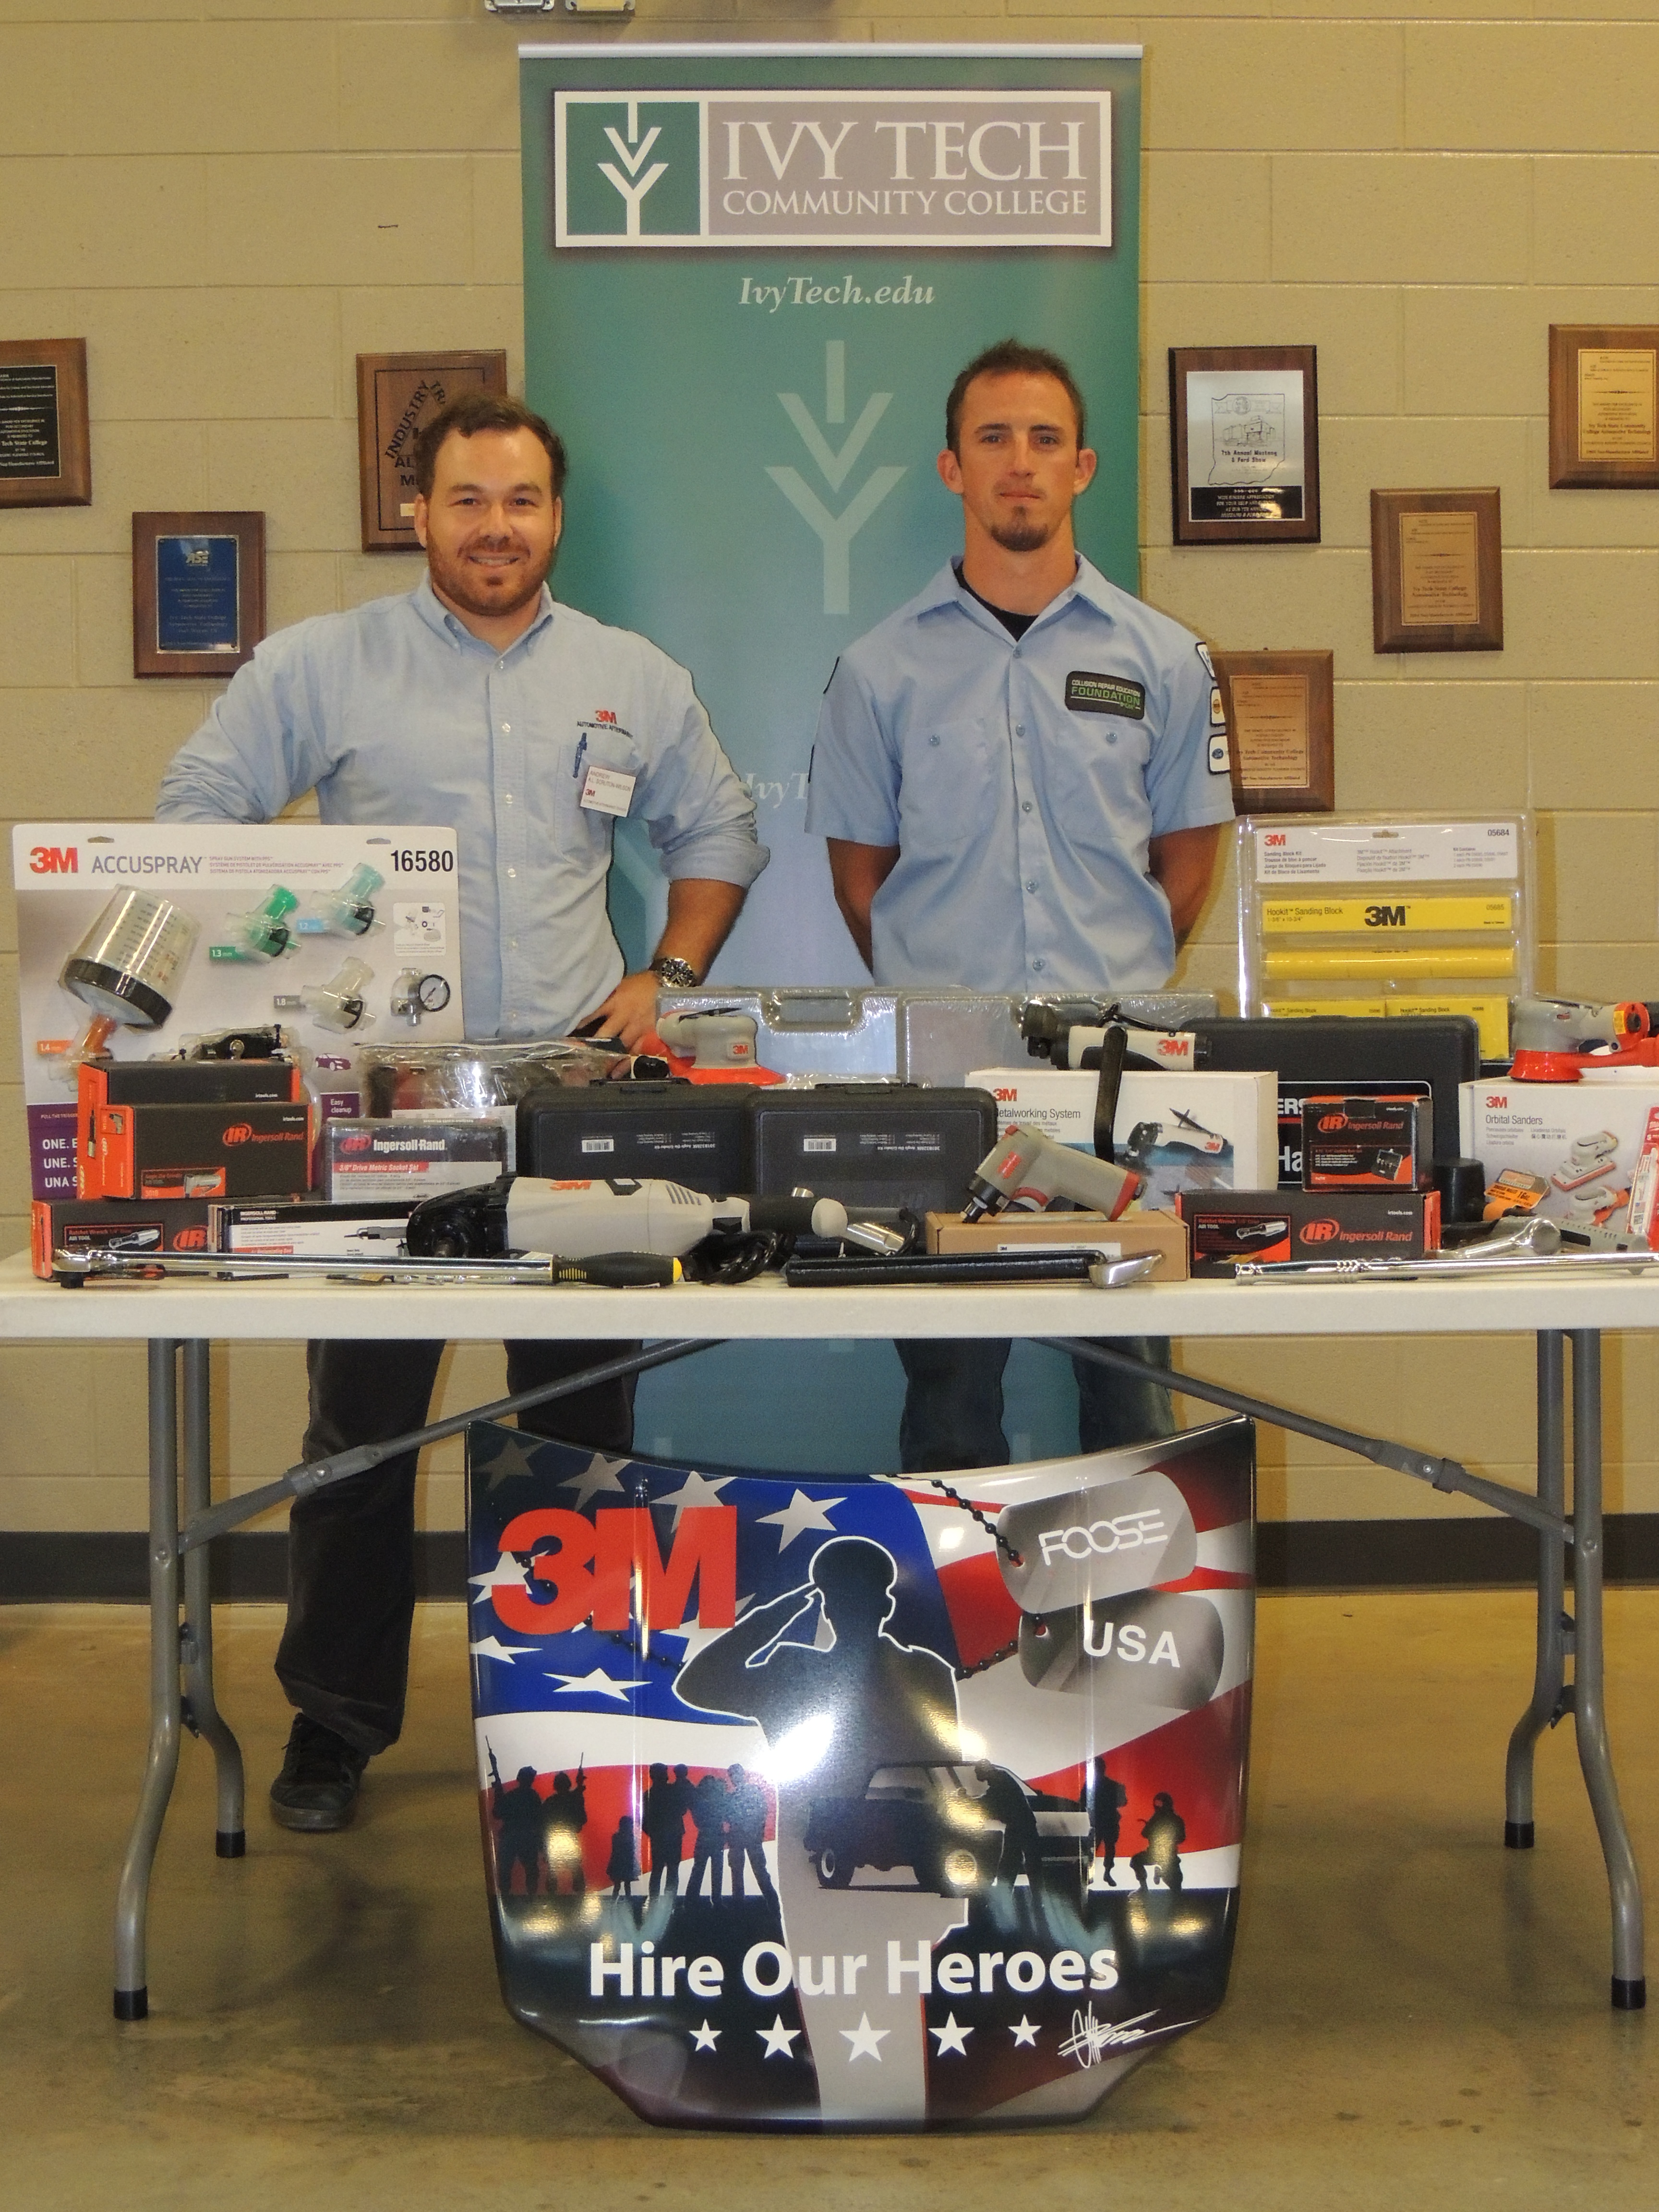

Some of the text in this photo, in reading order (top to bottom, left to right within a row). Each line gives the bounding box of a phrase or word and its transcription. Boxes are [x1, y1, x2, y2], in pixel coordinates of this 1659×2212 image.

[722, 120, 1087, 181] IVY TECH
[722, 190, 1087, 215] COMMUNITY COLLEGE
[738, 276, 935, 313] IvyTech.edu
[385, 380, 430, 459] INDUSTRY
[1071, 679, 1097, 688] COLLISION
[1116, 685, 1140, 697] EDUCATION
[1071, 686, 1140, 706] FOUNDATION
[595, 709, 617, 724] 3M
[585, 788, 595, 797] 3M
[1264, 834, 1286, 846] 3M
[29, 847, 78, 874] 3M
[390, 850, 454, 872] 16580
[1295, 907, 1322, 916] Sanding
[733, 1044, 748, 1054] 3M
[1157, 1039, 1189, 1056] 3M
[993, 1088, 1017, 1102] 3M
[1486, 1096, 1507, 1108] 3M
[331, 1106, 352, 1114] cleanup
[997, 1108, 1081, 1120] etalworking System
[1347, 1121, 1382, 1131] Ingersoll
[1486, 1115, 1543, 1126] Orbital Sanders
[42, 1138, 70, 1149] ONE.
[252, 1132, 304, 1144] Ingersoll Rand
[1204, 1142, 1221, 1151] 3M
[44, 1157, 70, 1168] UNE.
[45, 1176, 70, 1188] UNA
[550, 1180, 592, 1190] 3M
[1339, 1231, 1384, 1243] Ingersoll
[1385, 1231, 1413, 1242] Rand
[1038, 1508, 1168, 1566] FOOSE
[491, 1506, 737, 1635] 3M
[1083, 1620, 1180, 1668] USA
[591, 1940, 1119, 1997] Hire Our Heroes
